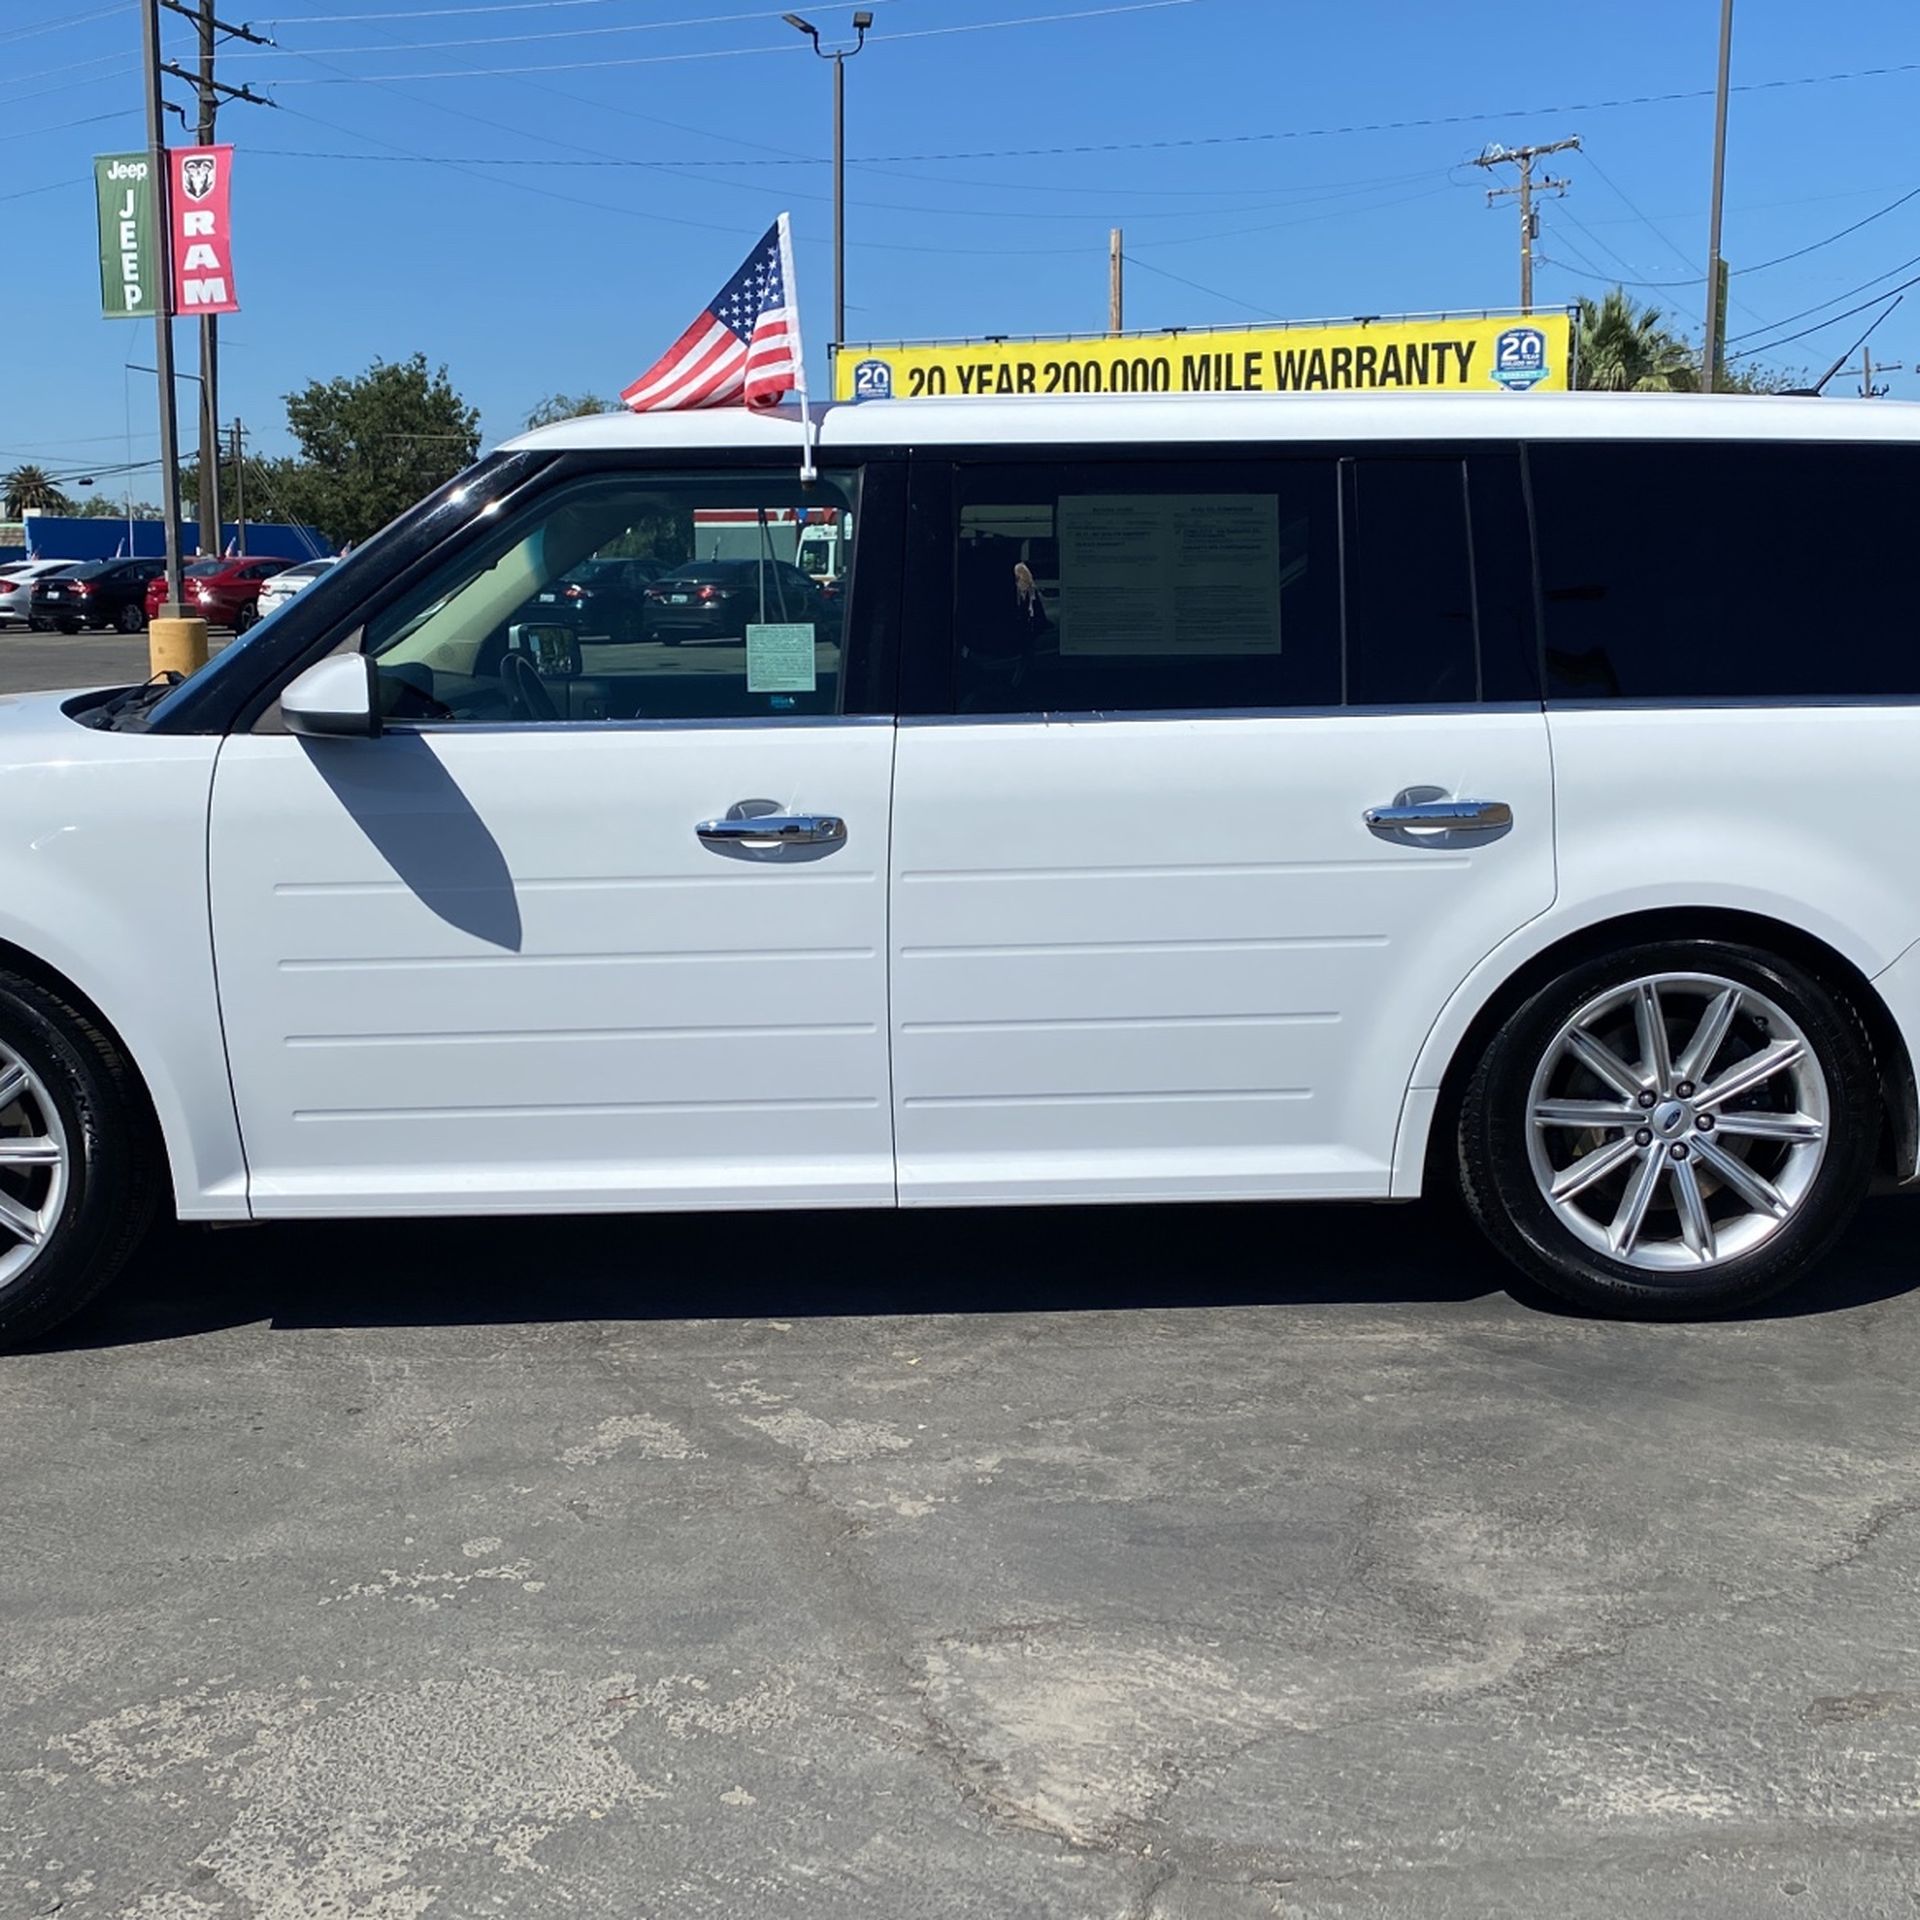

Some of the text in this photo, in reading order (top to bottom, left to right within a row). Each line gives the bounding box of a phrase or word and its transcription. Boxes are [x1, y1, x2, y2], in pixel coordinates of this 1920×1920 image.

[107, 161, 148, 181] Jeep
[119, 189, 143, 311] JEEP
[183, 210, 228, 305] RAM
[908, 366, 946, 397] 20
[956, 362, 1036, 395] YEAR
[1182, 351, 1263, 391] MILE
[1274, 340, 1477, 391] WARRANTY
[1501, 336, 1541, 361] 20
[858, 367, 889, 388] 20
